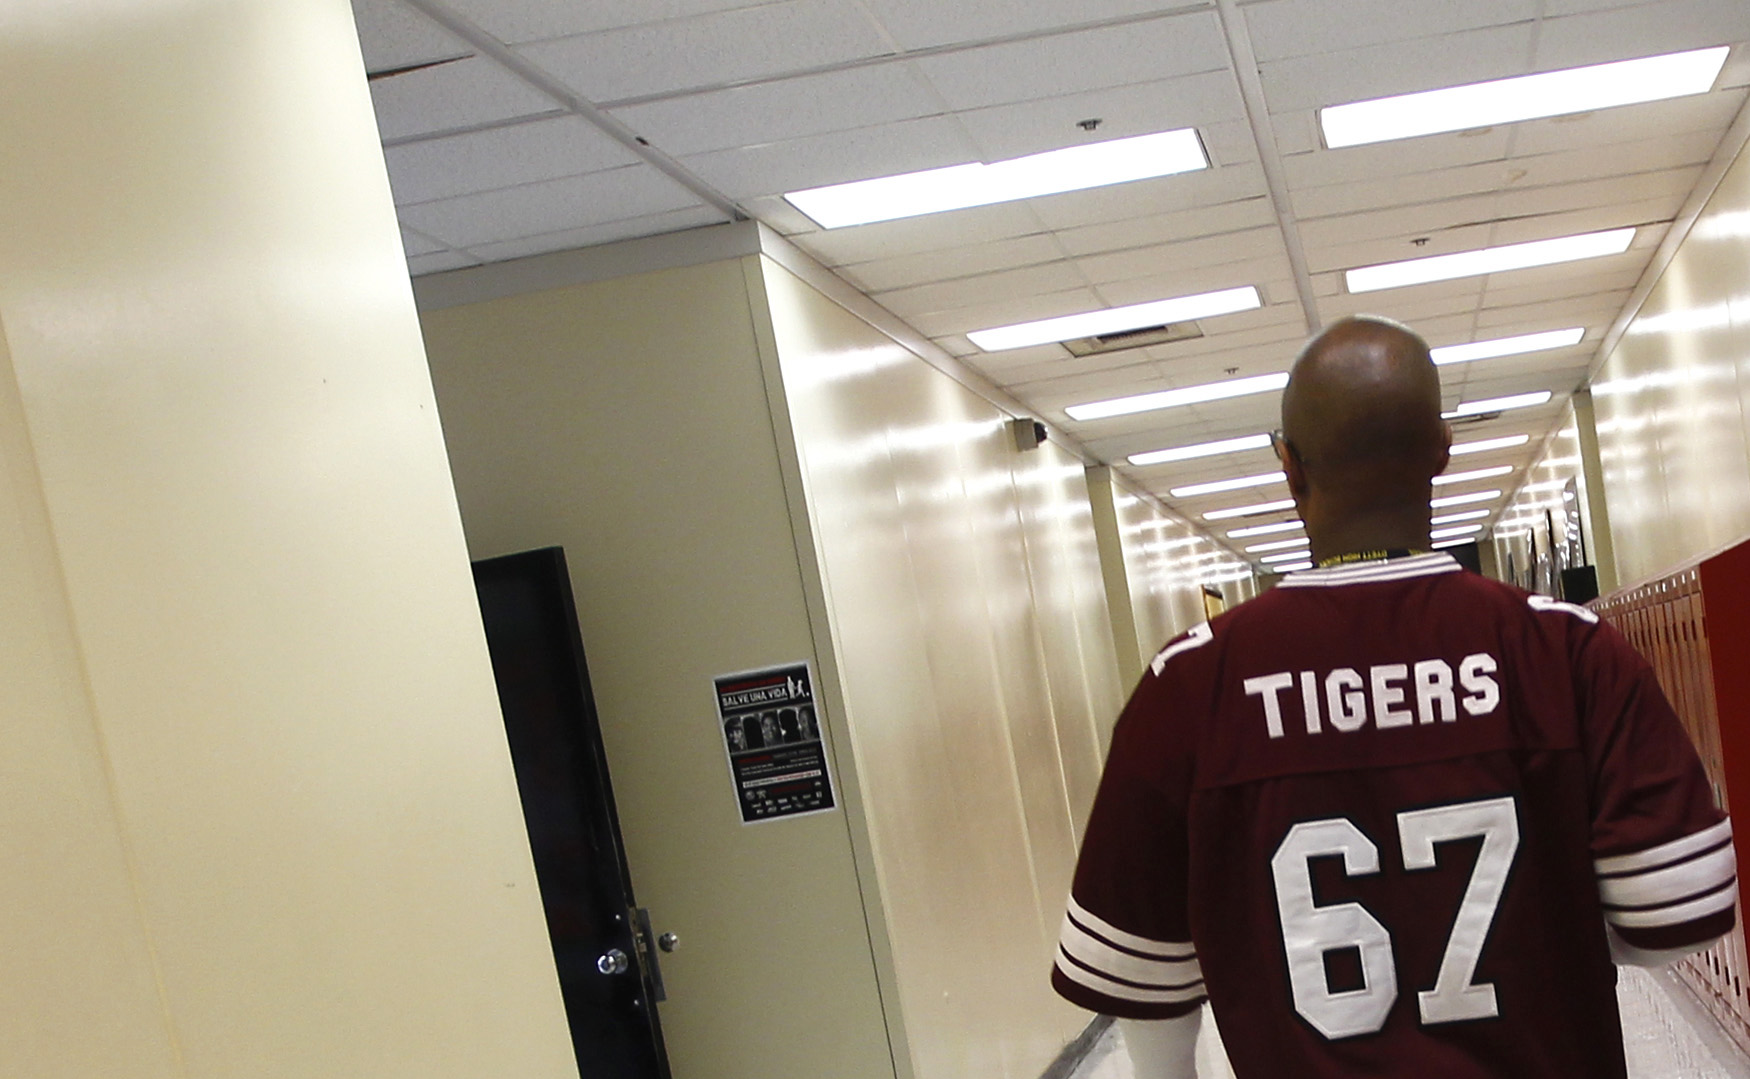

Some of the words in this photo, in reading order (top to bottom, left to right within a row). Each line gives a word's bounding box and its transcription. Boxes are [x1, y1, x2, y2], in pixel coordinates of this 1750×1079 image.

[750, 690, 767, 701] UNA
[768, 687, 787, 699] VIDA
[1243, 652, 1501, 740] TIGERS
[1270, 796, 1520, 1040] 67
